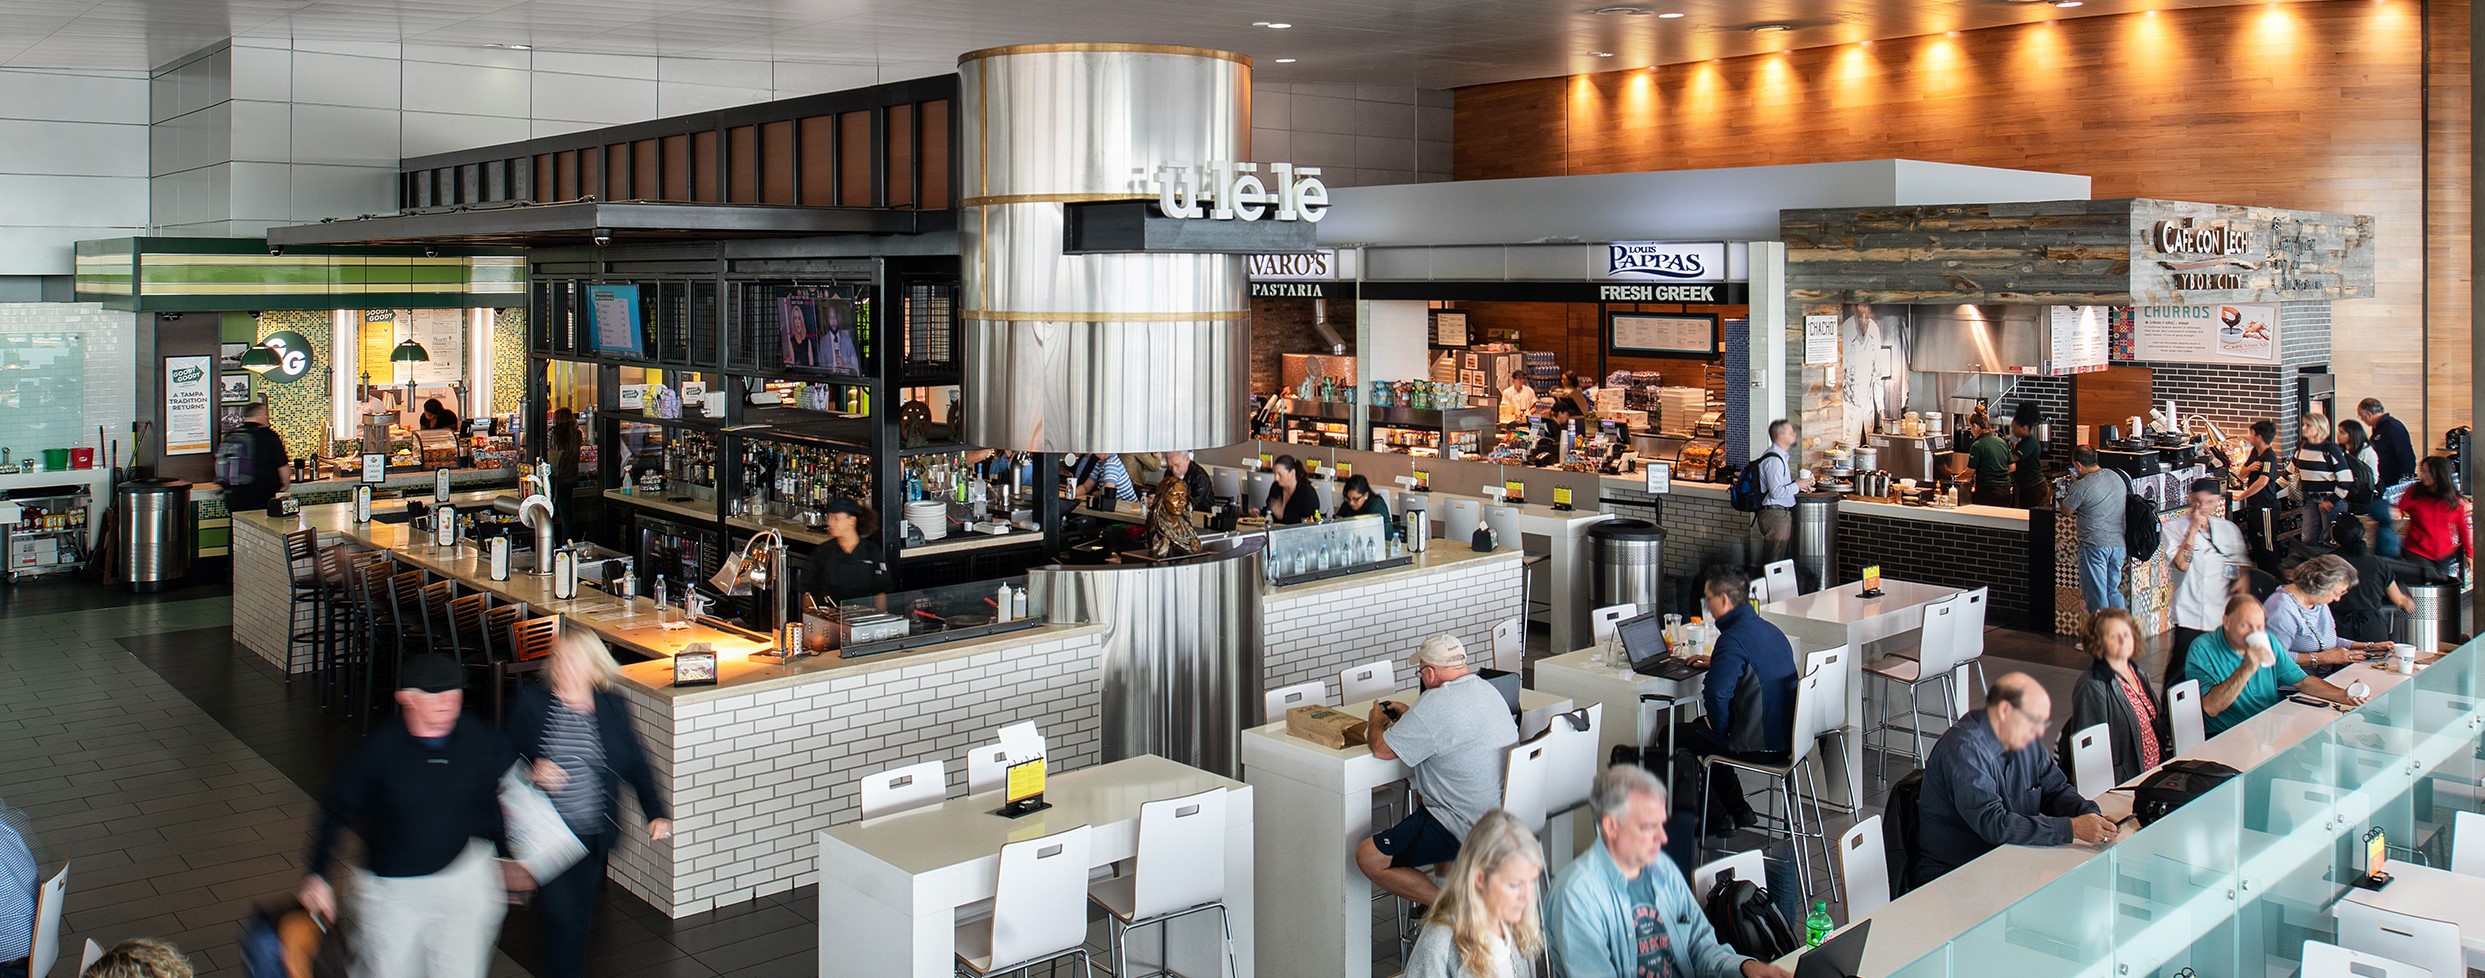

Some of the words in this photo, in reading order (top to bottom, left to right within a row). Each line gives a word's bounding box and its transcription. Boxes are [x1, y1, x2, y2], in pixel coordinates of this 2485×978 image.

[1628, 245, 1657, 254] LOUIS
[1250, 253, 1327, 276] VARO'S
[1608, 245, 1702, 272] PAPPAS
[2181, 273, 2212, 290] YBOR
[2217, 273, 2243, 290] CITY
[1251, 283, 1323, 297] PASTARIA
[1600, 285, 1653, 301] FRESH
[1655, 285, 1714, 302] GREEK
[368, 312, 393, 322] GOODY
[2144, 305, 2210, 319] CHURROS
[173, 367, 197, 378] GOODY
[177, 371, 201, 382] GOODY
[169, 397, 208, 405] TRADITION
[172, 403, 205, 411] RETURNS
